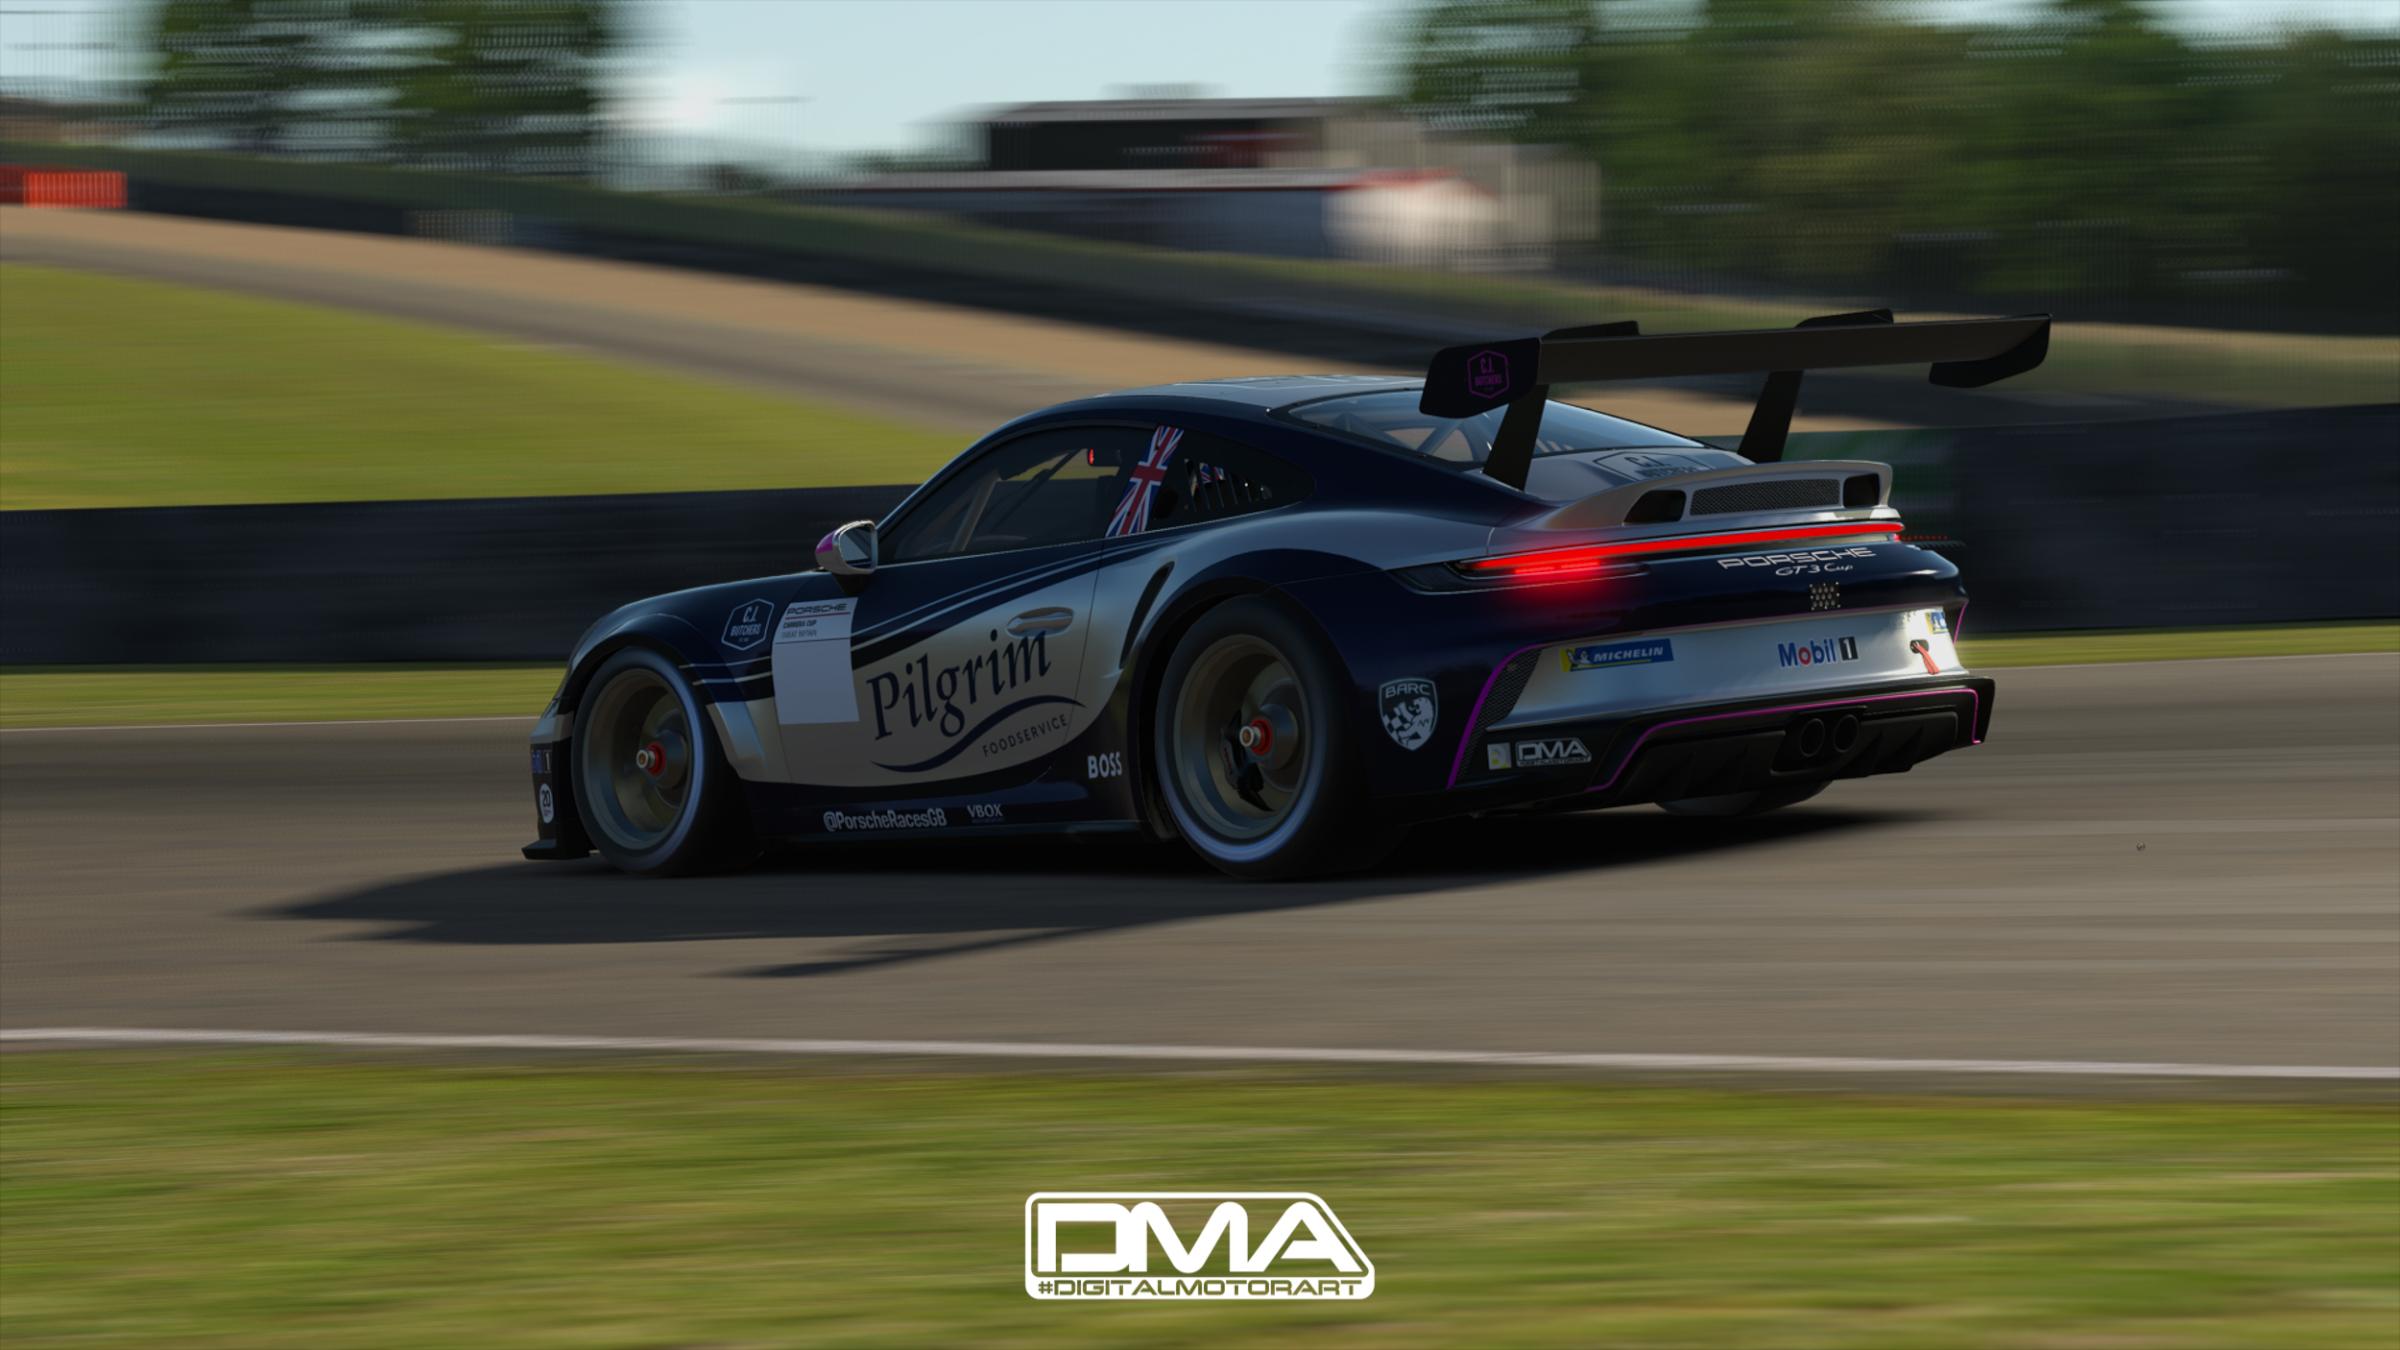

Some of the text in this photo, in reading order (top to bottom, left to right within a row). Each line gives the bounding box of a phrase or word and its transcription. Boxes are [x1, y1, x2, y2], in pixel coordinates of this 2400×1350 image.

[1717, 547, 1876, 569] PORSCHE
[1824, 562, 1853, 573] Cup
[786, 603, 848, 616] PORSCHE
[1594, 646, 1664, 663] MICHELIN
[1777, 638, 1855, 667] Mobil 1
[866, 628, 1050, 741] Pilgrim
[1385, 683, 1431, 699] BARC
[982, 713, 1068, 758] FOODSERVICE
[1518, 740, 1588, 760] DMA
[1087, 752, 1123, 779] BOSS
[823, 807, 947, 832] @PorscheRacesGB
[966, 803, 1004, 818] VBOX
